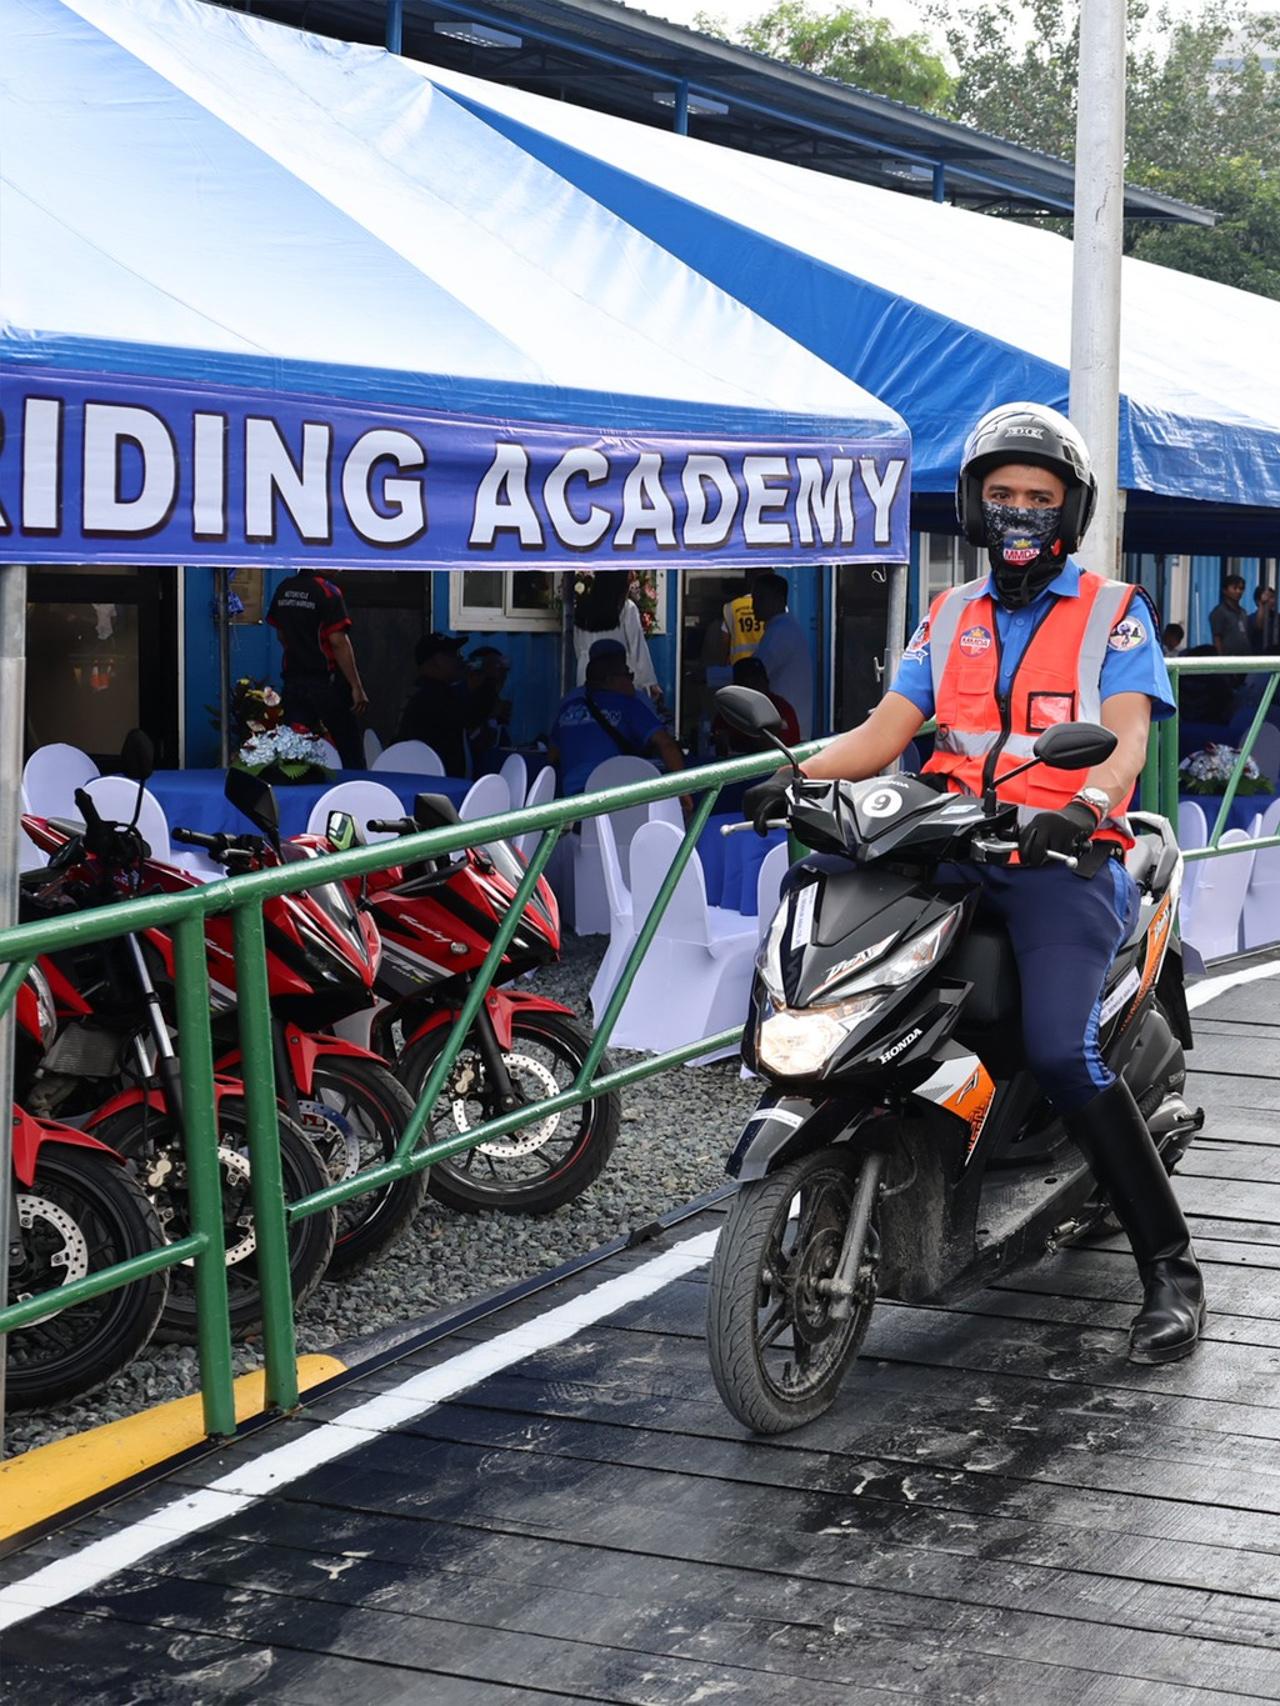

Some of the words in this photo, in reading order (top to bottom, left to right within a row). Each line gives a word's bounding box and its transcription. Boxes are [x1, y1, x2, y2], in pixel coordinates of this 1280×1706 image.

[0, 396, 428, 546] IDING
[468, 442, 907, 549] ACADEMY
[871, 794, 892, 812] 9
[879, 1027, 923, 1065] HONDA
